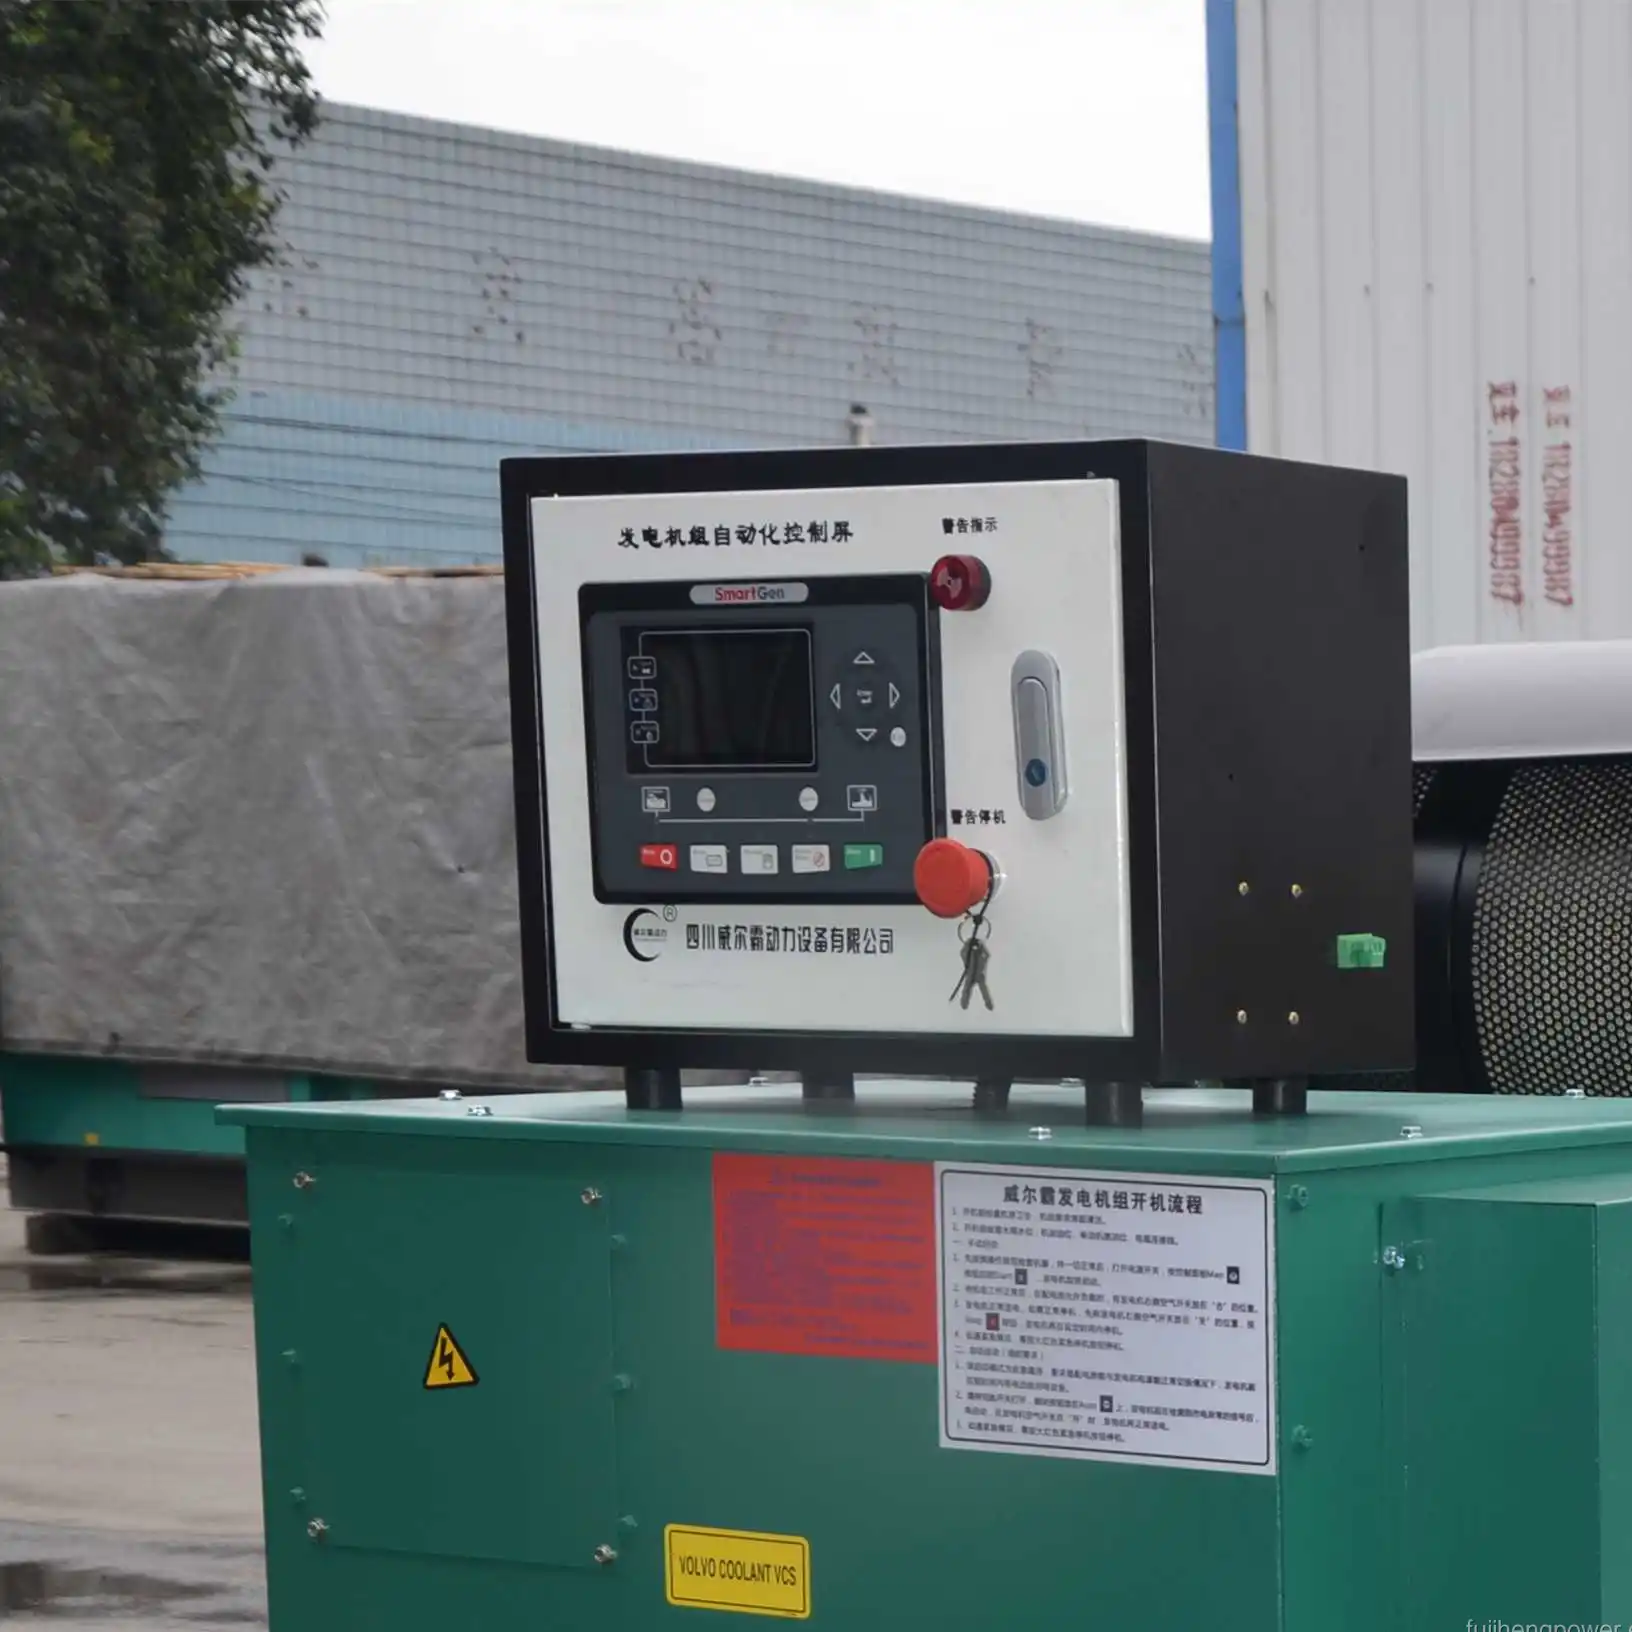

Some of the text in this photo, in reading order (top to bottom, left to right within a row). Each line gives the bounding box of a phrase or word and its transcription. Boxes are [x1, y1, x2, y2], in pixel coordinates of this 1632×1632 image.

[617, 520, 853, 549] 发电机组自动化控制屏
[942, 516, 998, 535] 警告指示
[714, 585, 785, 602] SmartGen
[950, 808, 1006, 826] 警告停机
[1003, 1184, 1203, 1215] 威尔霸发电机组开机流程
[679, 1555, 797, 1586] VOLVO COOLANT VCS
